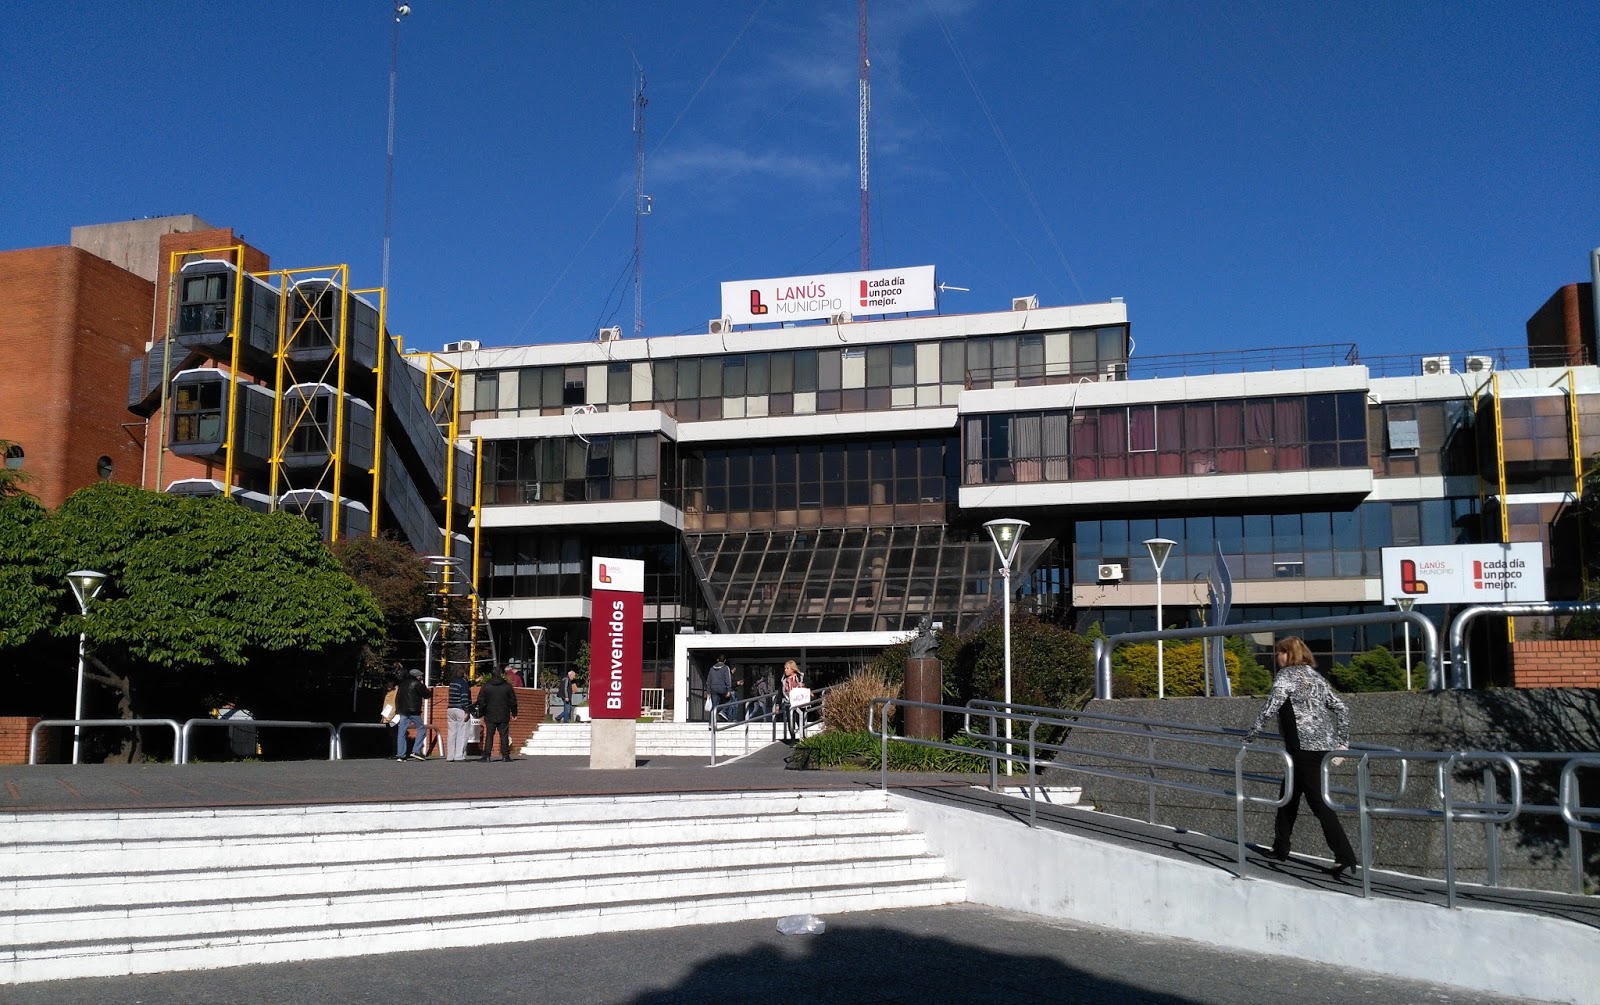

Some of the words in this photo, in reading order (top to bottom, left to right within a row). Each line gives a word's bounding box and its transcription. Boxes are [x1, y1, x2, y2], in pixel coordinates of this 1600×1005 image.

[868, 278, 890, 288] cada
[891, 276, 905, 286] día
[776, 281, 826, 301] LANÚS
[868, 289, 881, 298] un
[881, 288, 902, 299] poco
[776, 298, 842, 314] MUNICIPIO
[868, 298, 897, 307] mejor.
[1420, 560, 1446, 569] LANÚS
[1483, 559, 1507, 569] cada
[1509, 558, 1525, 568] día
[1420, 568, 1454, 576] MUNICIPIO
[1484, 571, 1497, 579] un
[1498, 570, 1522, 581] poco
[1484, 580, 1517, 590] mejor.
[606, 600, 624, 710] Bienvenidos
